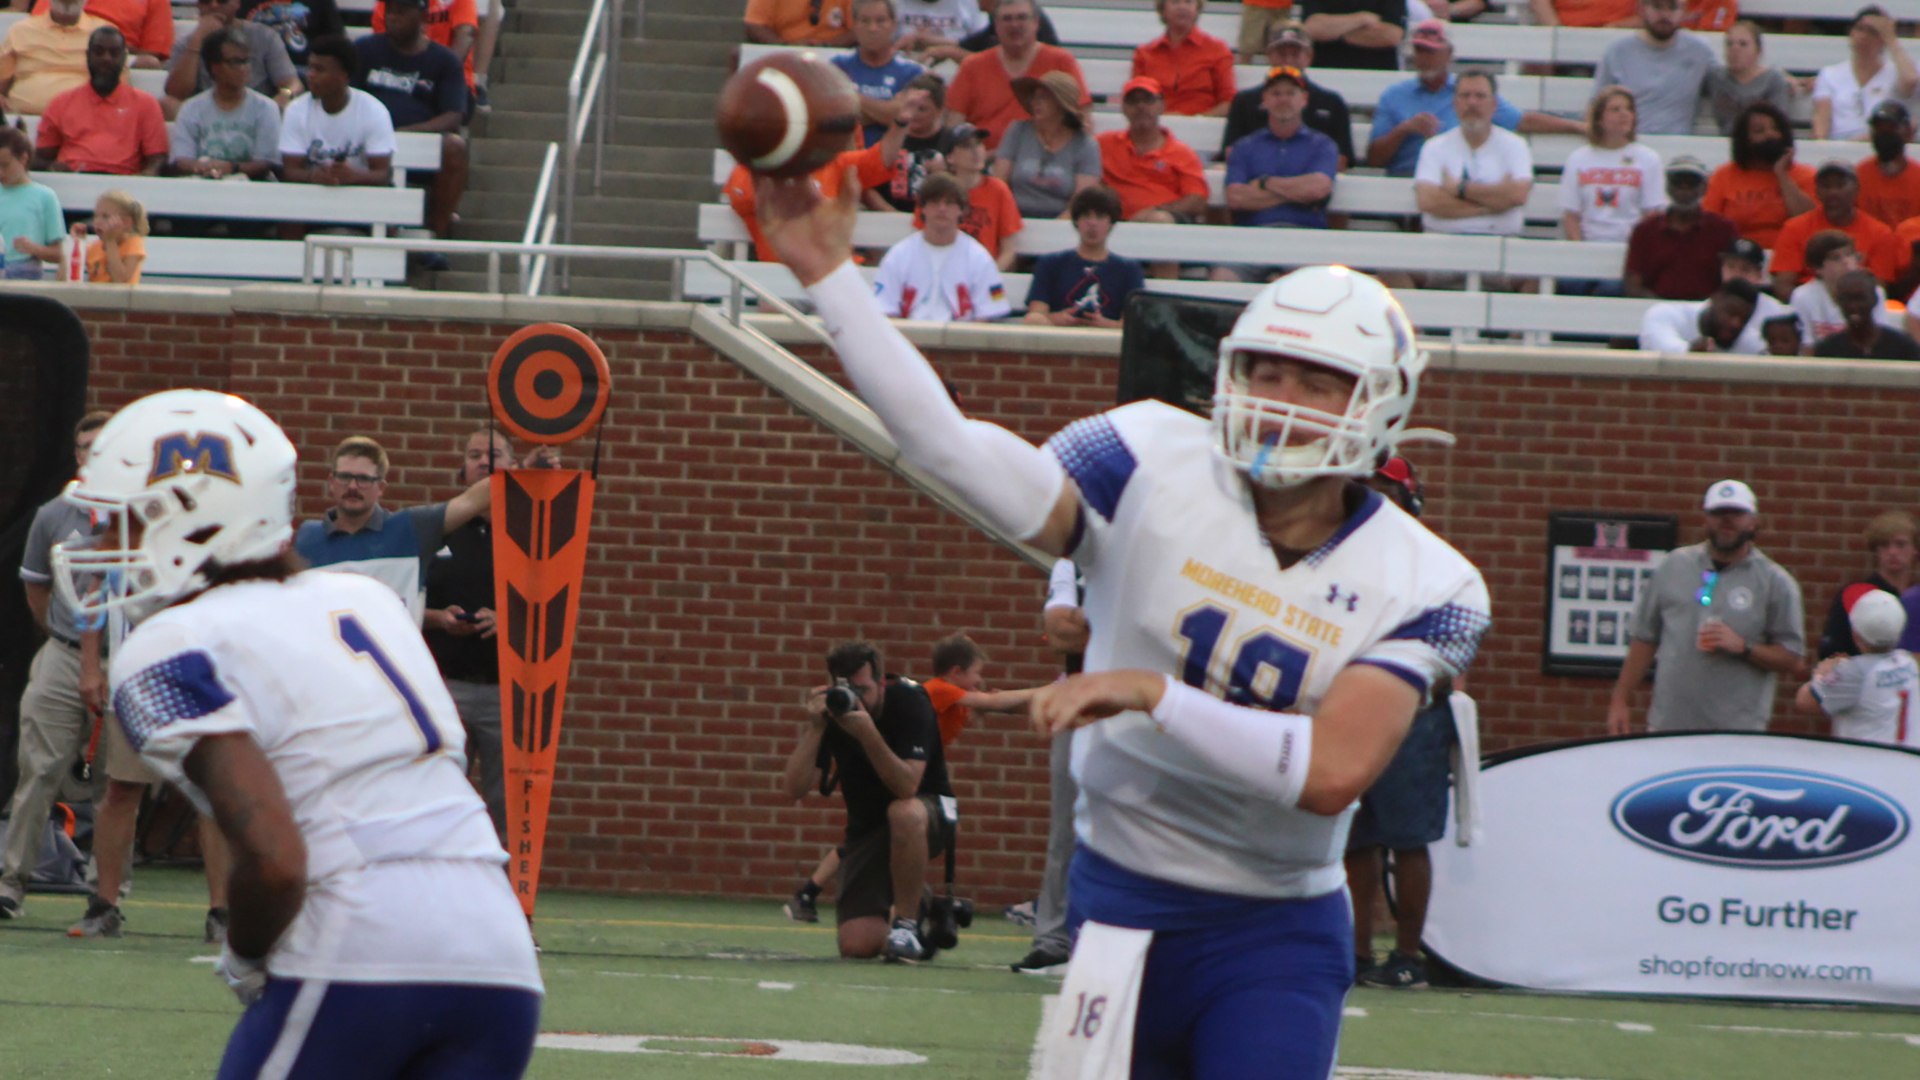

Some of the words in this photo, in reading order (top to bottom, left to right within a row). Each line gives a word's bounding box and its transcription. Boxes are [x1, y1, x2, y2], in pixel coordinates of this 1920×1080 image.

[1180, 557, 1282, 618] MOREHEAD
[1282, 603, 1345, 648] STATE
[328, 608, 446, 757] 1
[1171, 597, 1319, 712] 18
[518, 778, 534, 896] FISHER
[1669, 781, 1851, 852] Ford
[1657, 896, 1711, 925] Go
[1720, 898, 1859, 931] Further
[1639, 954, 1873, 983] shopfordnow.com
[1067, 991, 1108, 1040] 18
